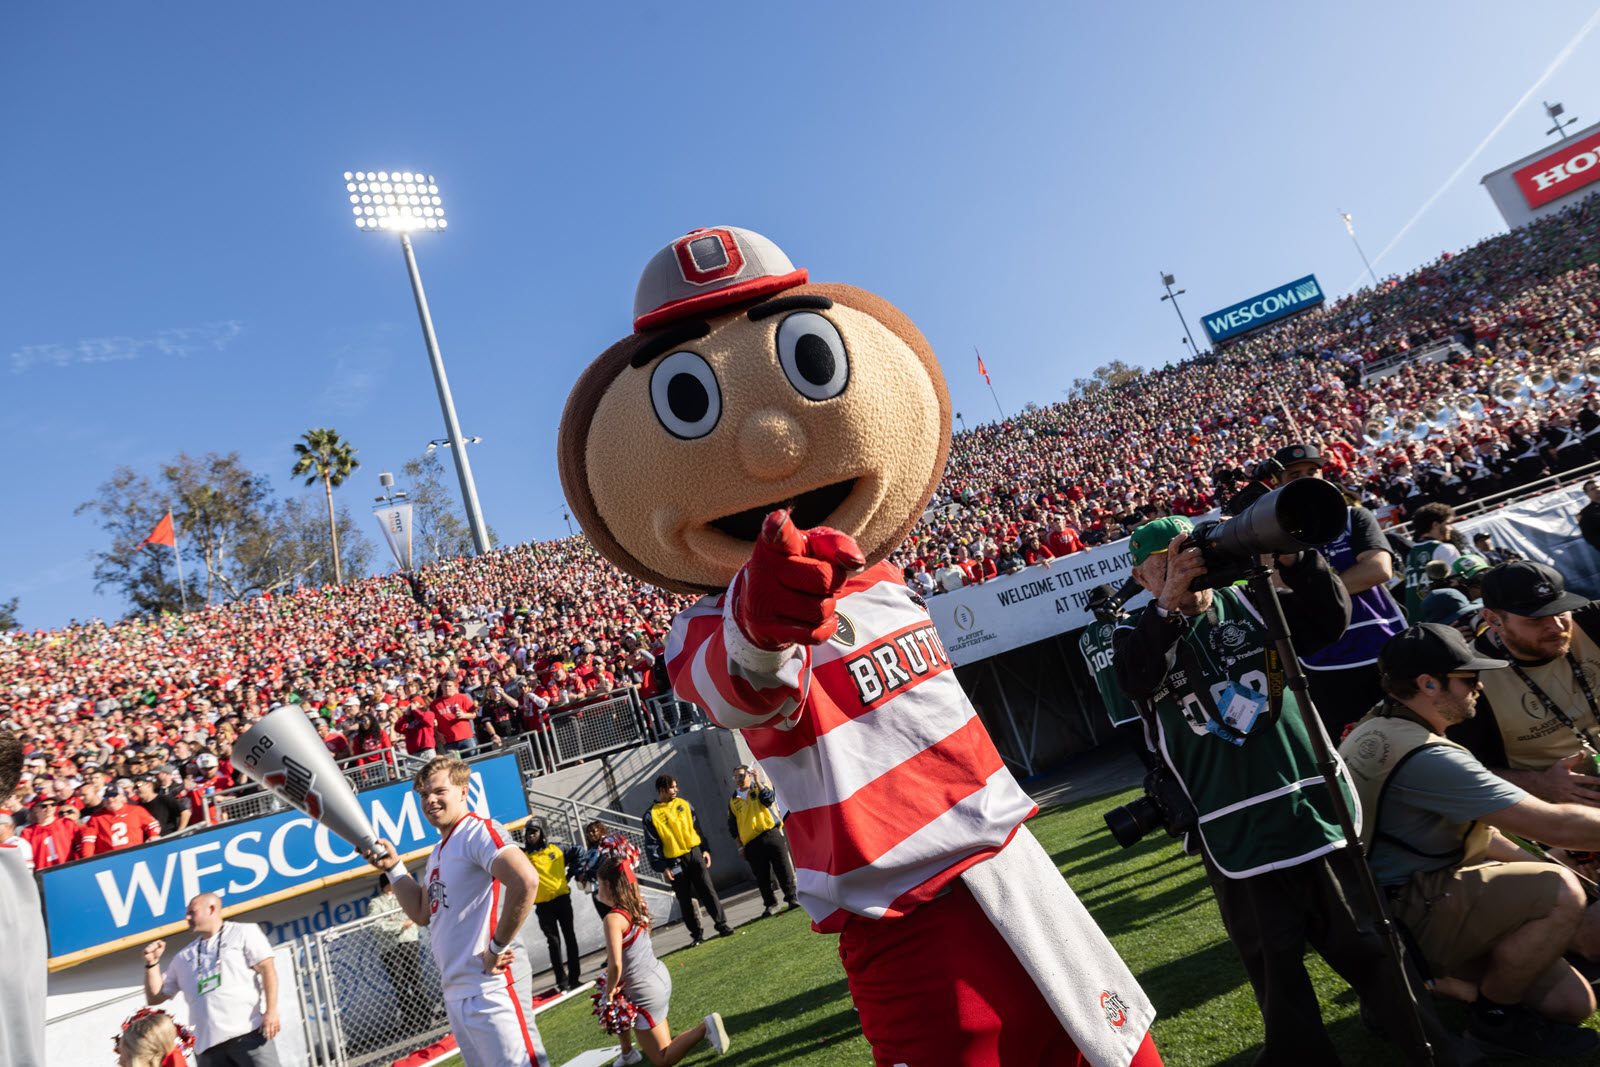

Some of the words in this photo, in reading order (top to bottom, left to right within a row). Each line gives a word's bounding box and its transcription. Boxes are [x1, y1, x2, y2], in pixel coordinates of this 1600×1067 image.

[1530, 145, 1600, 191] HO
[672, 228, 747, 287] O
[1208, 289, 1298, 334] WESCOM
[997, 576, 1056, 607] WELCOME
[1055, 570, 1073, 588] TO
[1073, 560, 1098, 583] THE
[1055, 597, 1069, 614] AT
[43, 835, 59, 862] 1
[111, 822, 129, 846] 2
